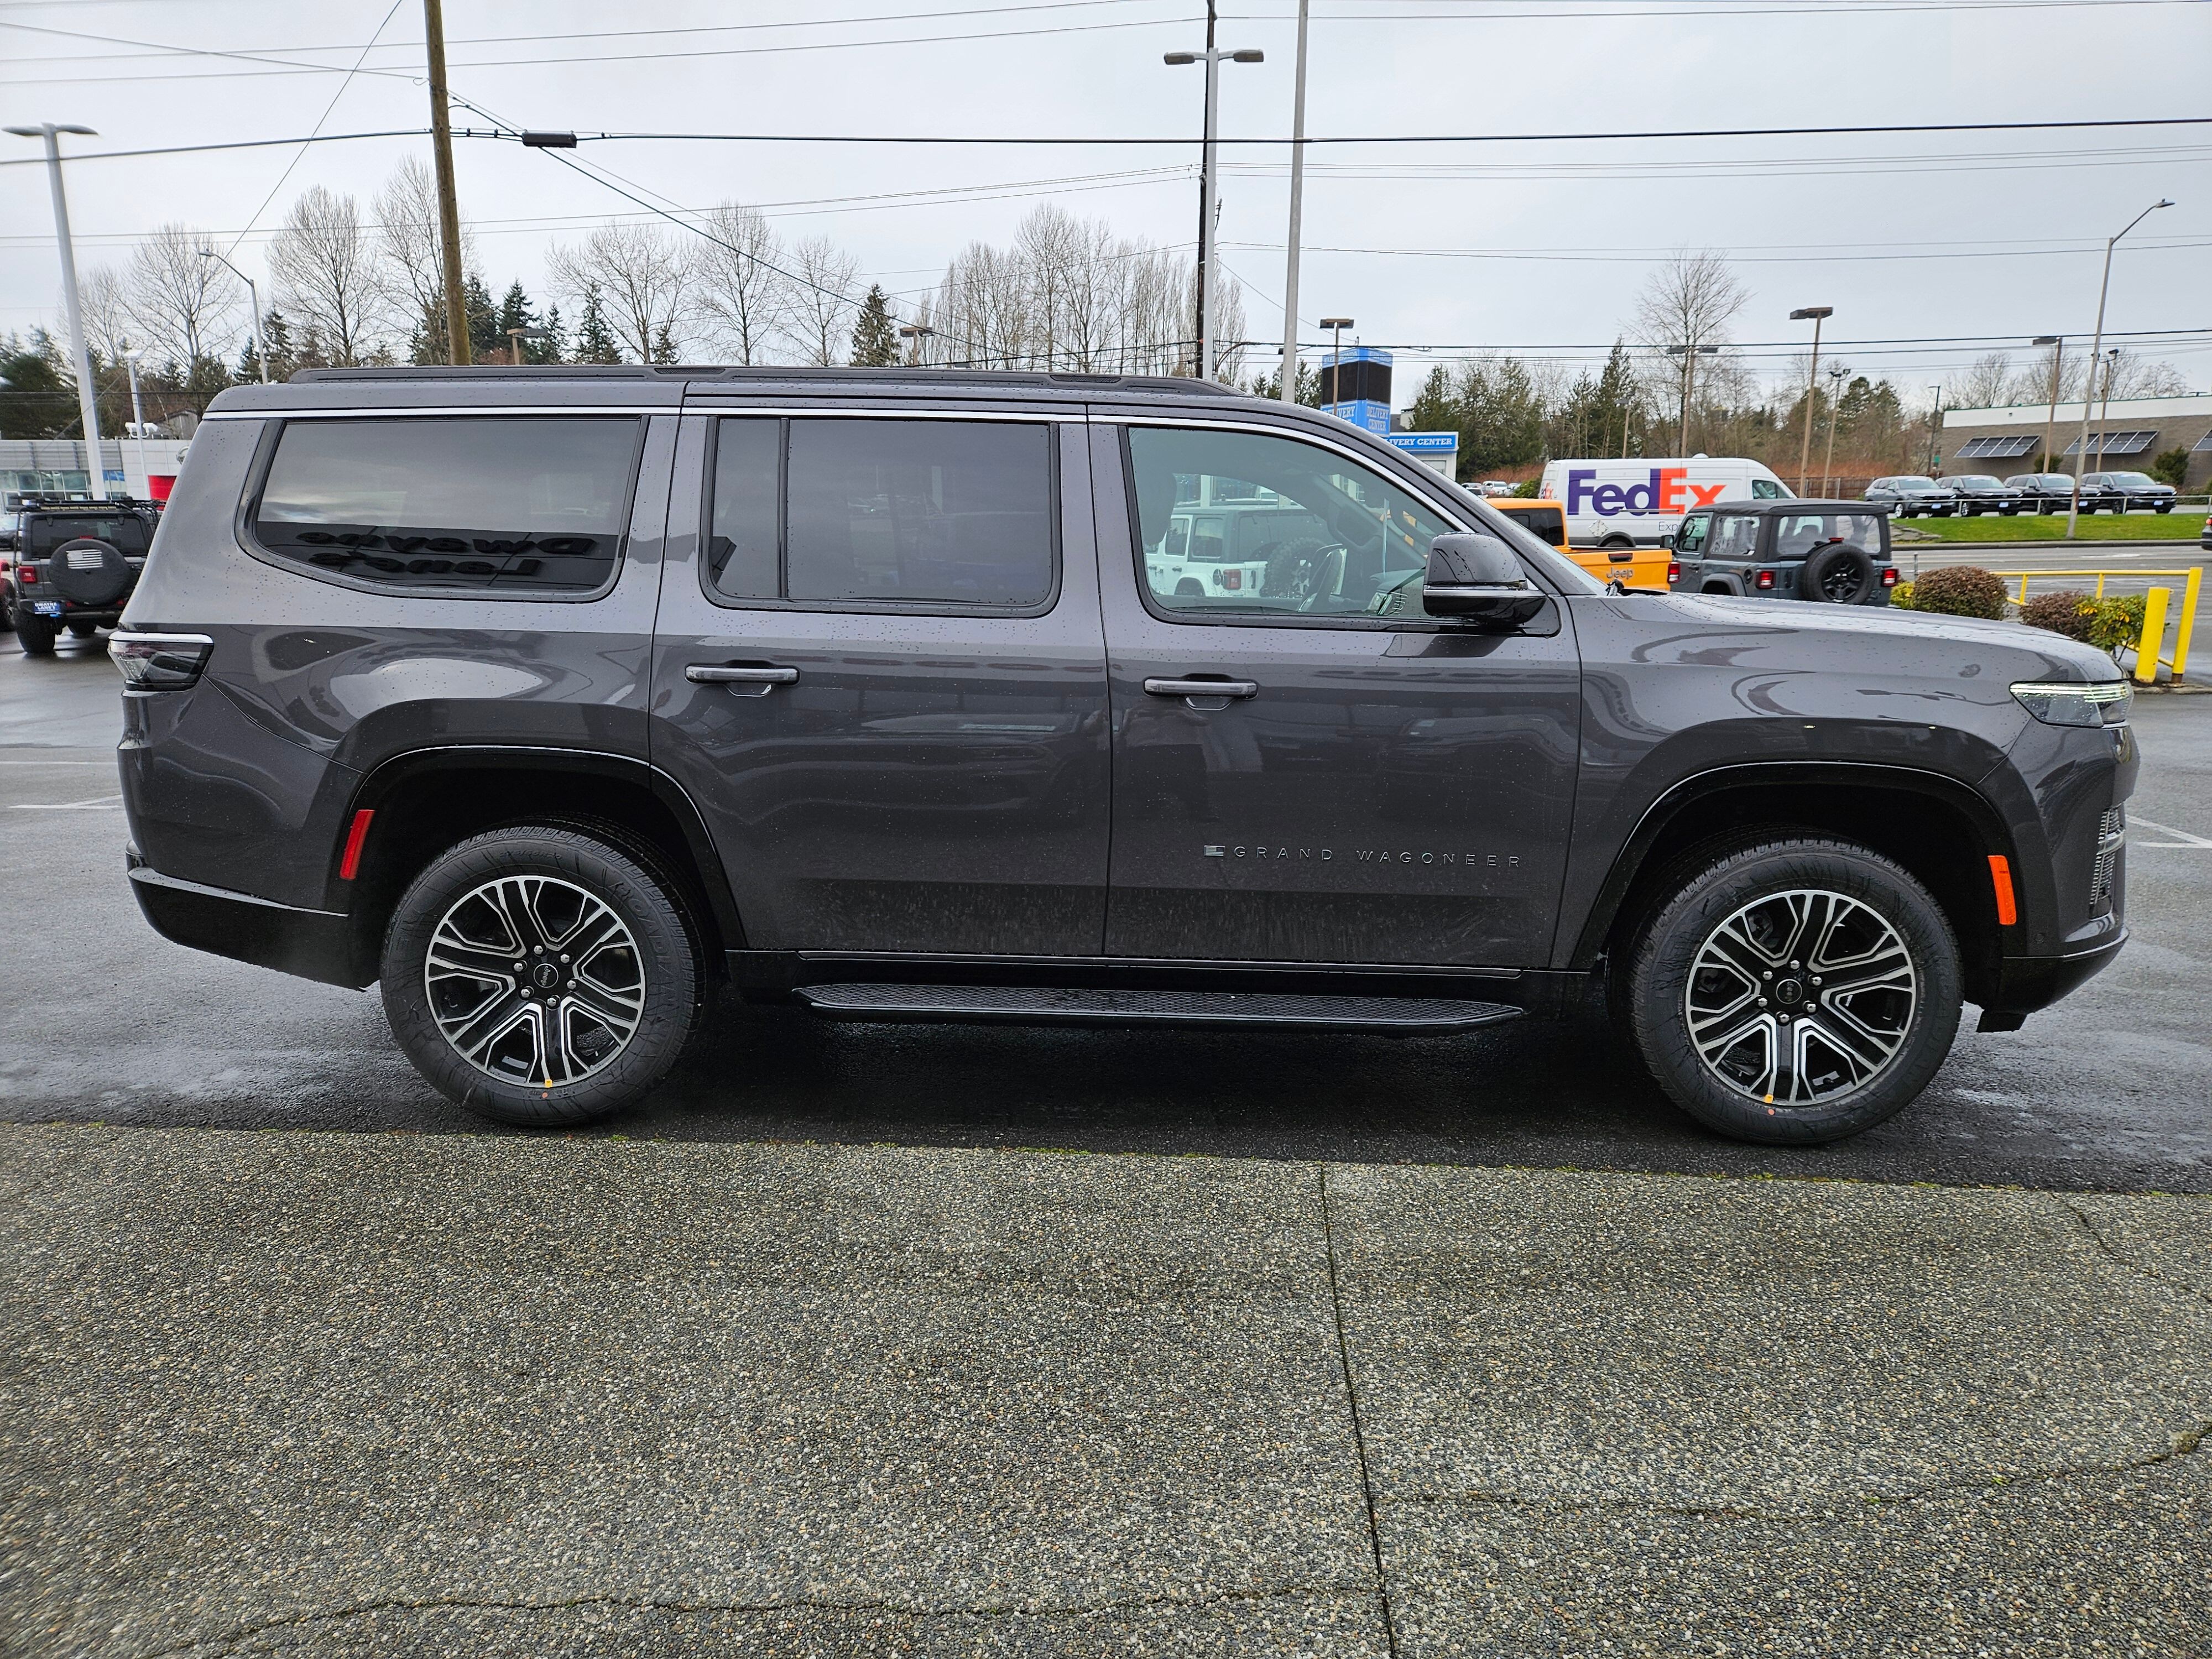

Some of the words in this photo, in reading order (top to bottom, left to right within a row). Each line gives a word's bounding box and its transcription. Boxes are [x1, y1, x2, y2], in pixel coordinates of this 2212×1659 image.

[1367, 406, 1389, 419] DELIVERY
[1368, 419, 1386, 431] CENTER
[1567, 468, 1727, 517] FedEx
[1606, 566, 1633, 580] Jeep
[1234, 846, 1333, 860] GRAND
[1356, 850, 1520, 867] WAGONEER
[540, 966, 551, 986] Jeep
